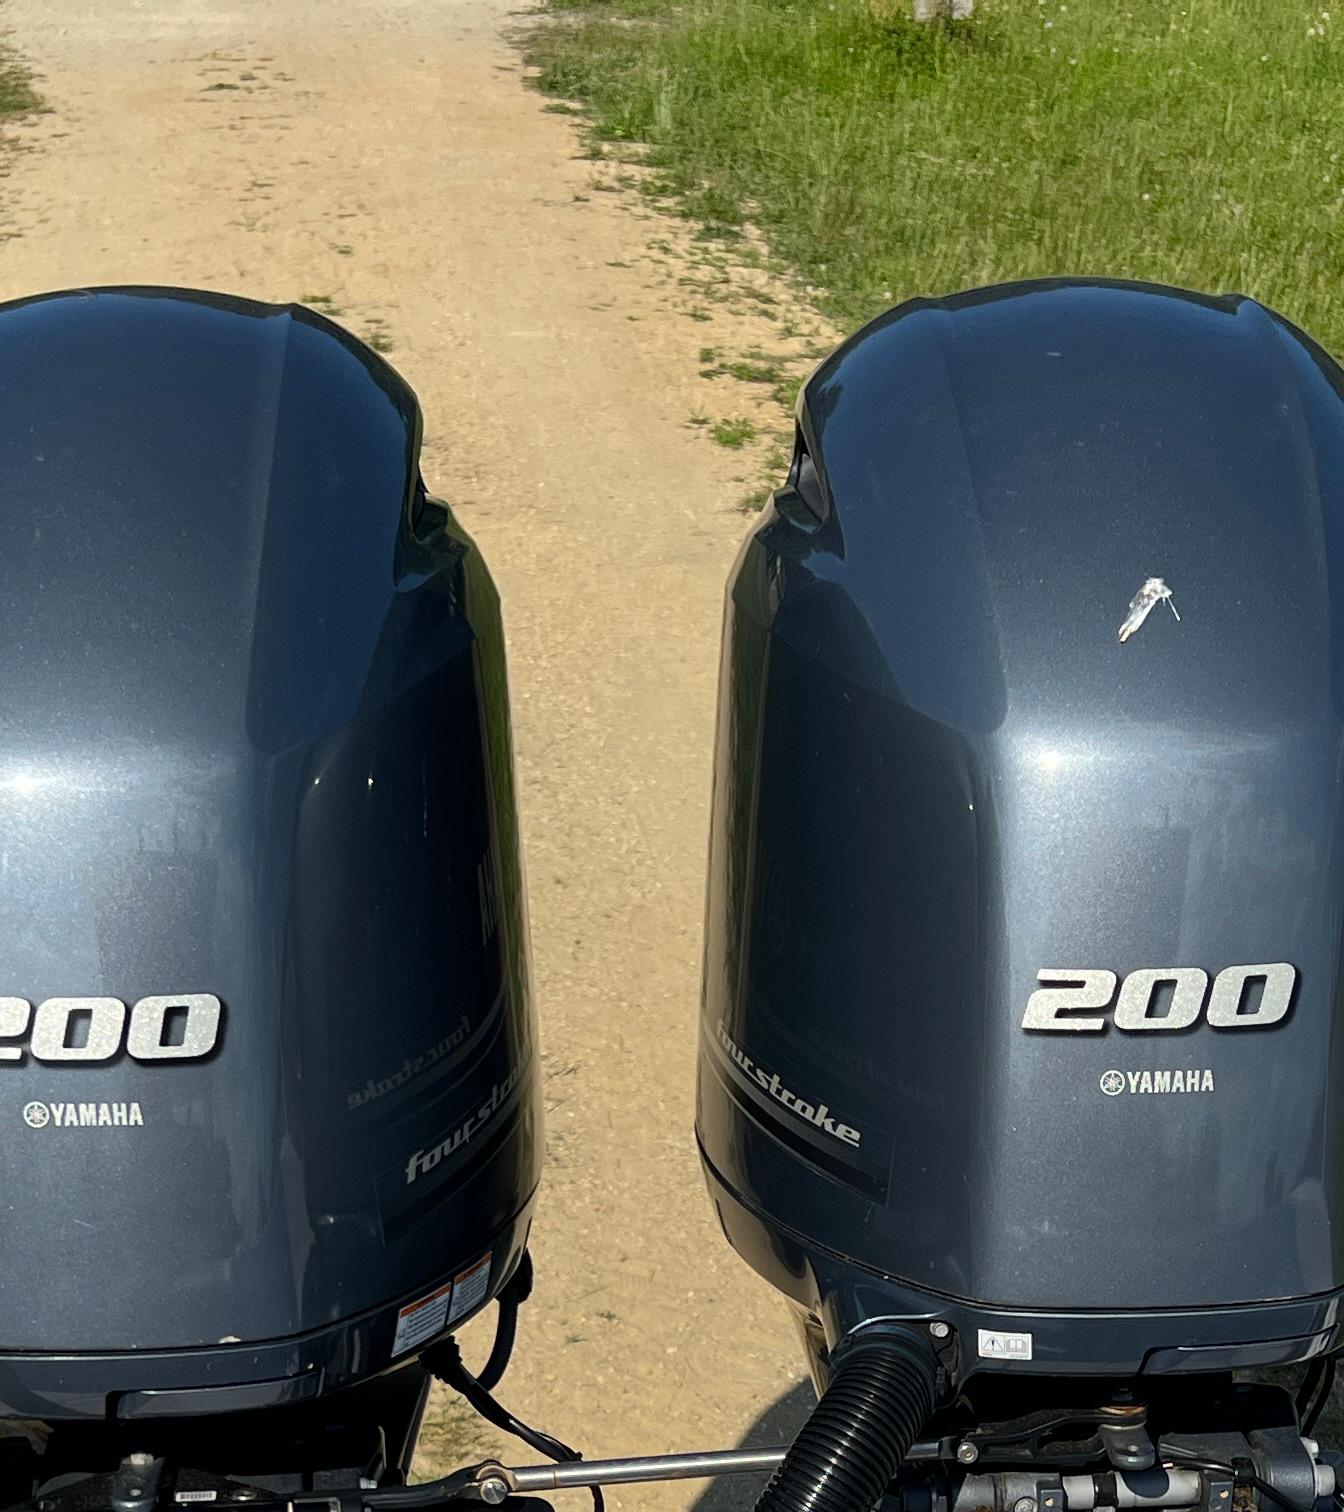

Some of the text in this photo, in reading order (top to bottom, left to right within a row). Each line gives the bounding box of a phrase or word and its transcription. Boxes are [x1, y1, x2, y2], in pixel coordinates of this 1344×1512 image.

[1021, 962, 1296, 1030] 200
[1127, 1069, 1214, 1094] YAMAHA
[49, 1102, 144, 1127] YAMAHA
